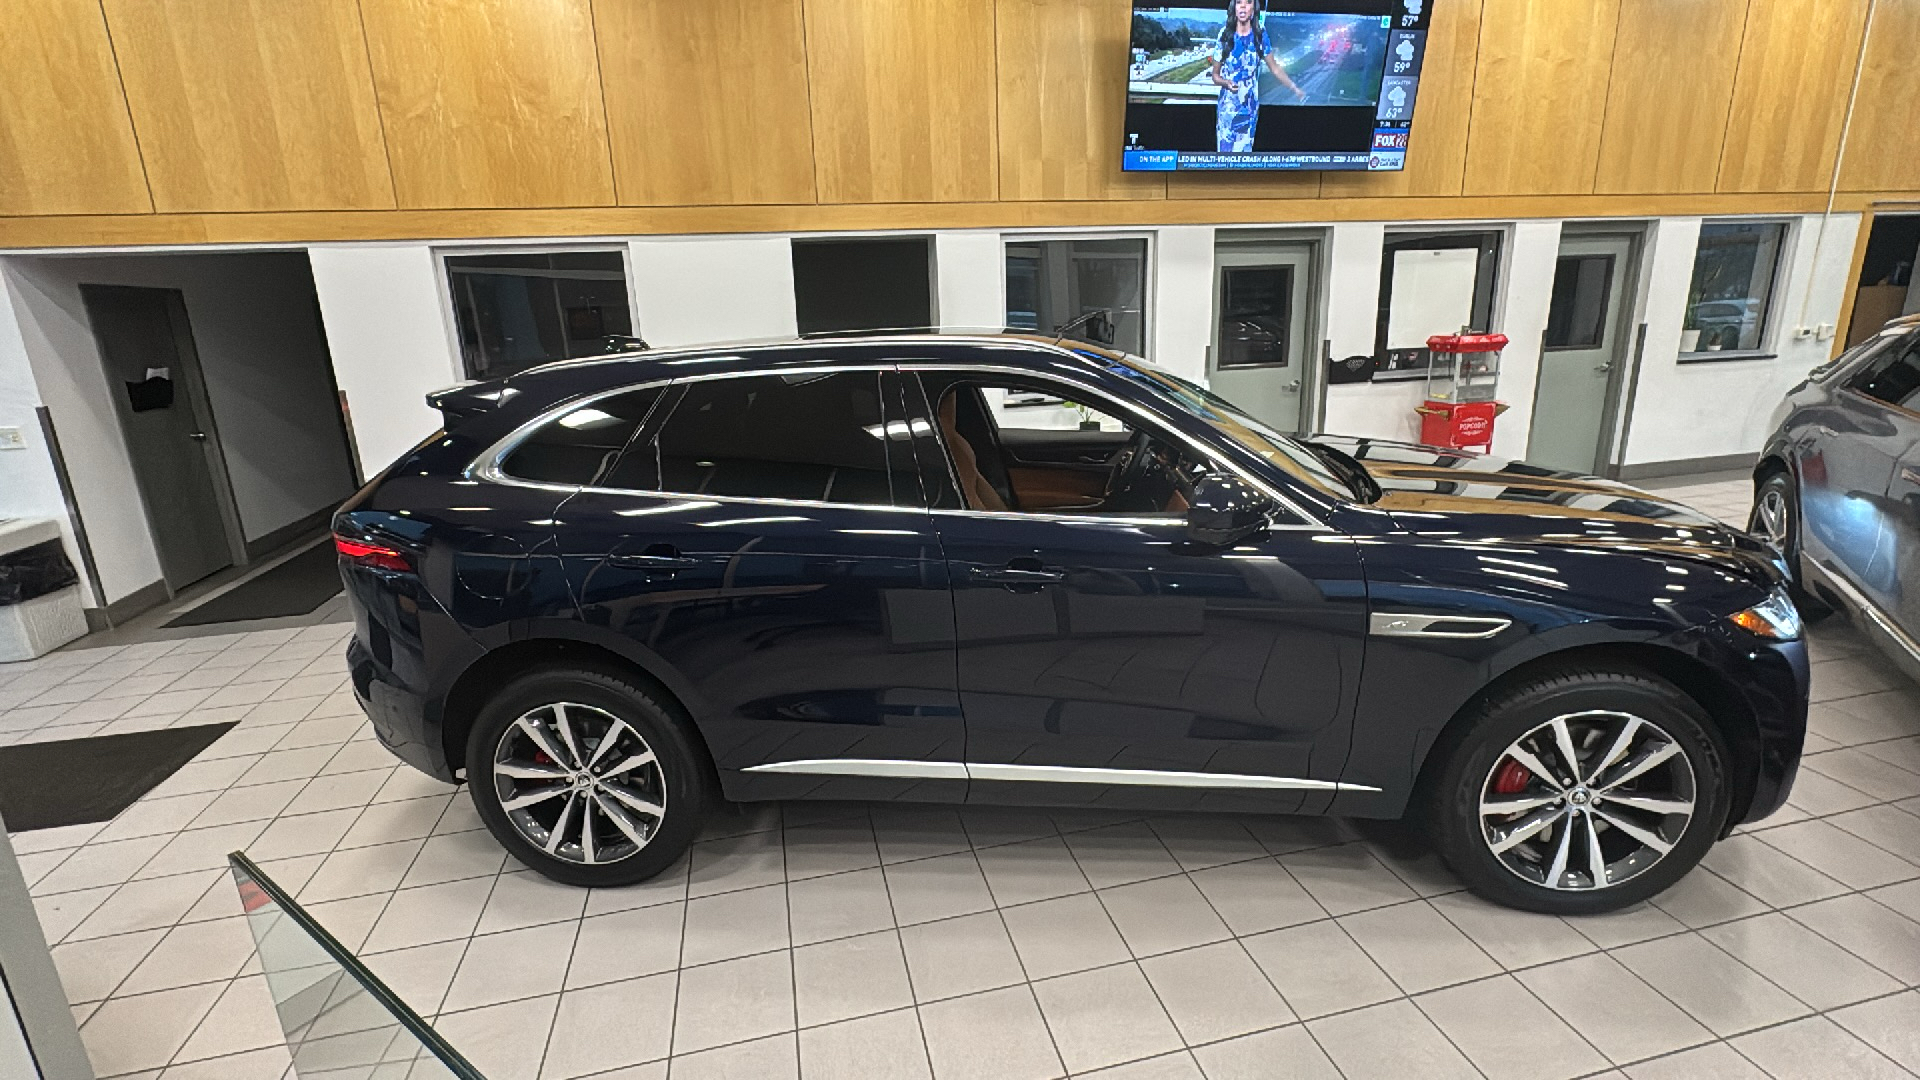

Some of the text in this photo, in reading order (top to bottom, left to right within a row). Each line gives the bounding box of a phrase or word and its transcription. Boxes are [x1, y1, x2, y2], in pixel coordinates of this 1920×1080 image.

[1375, 135, 1396, 146] FOX
[1149, 155, 1161, 163] THE
[1161, 155, 1175, 163] APP
[1242, 155, 1262, 163] CRASH
[1261, 155, 1281, 163] ALONG
[1296, 155, 1331, 163] WESTBOUND
